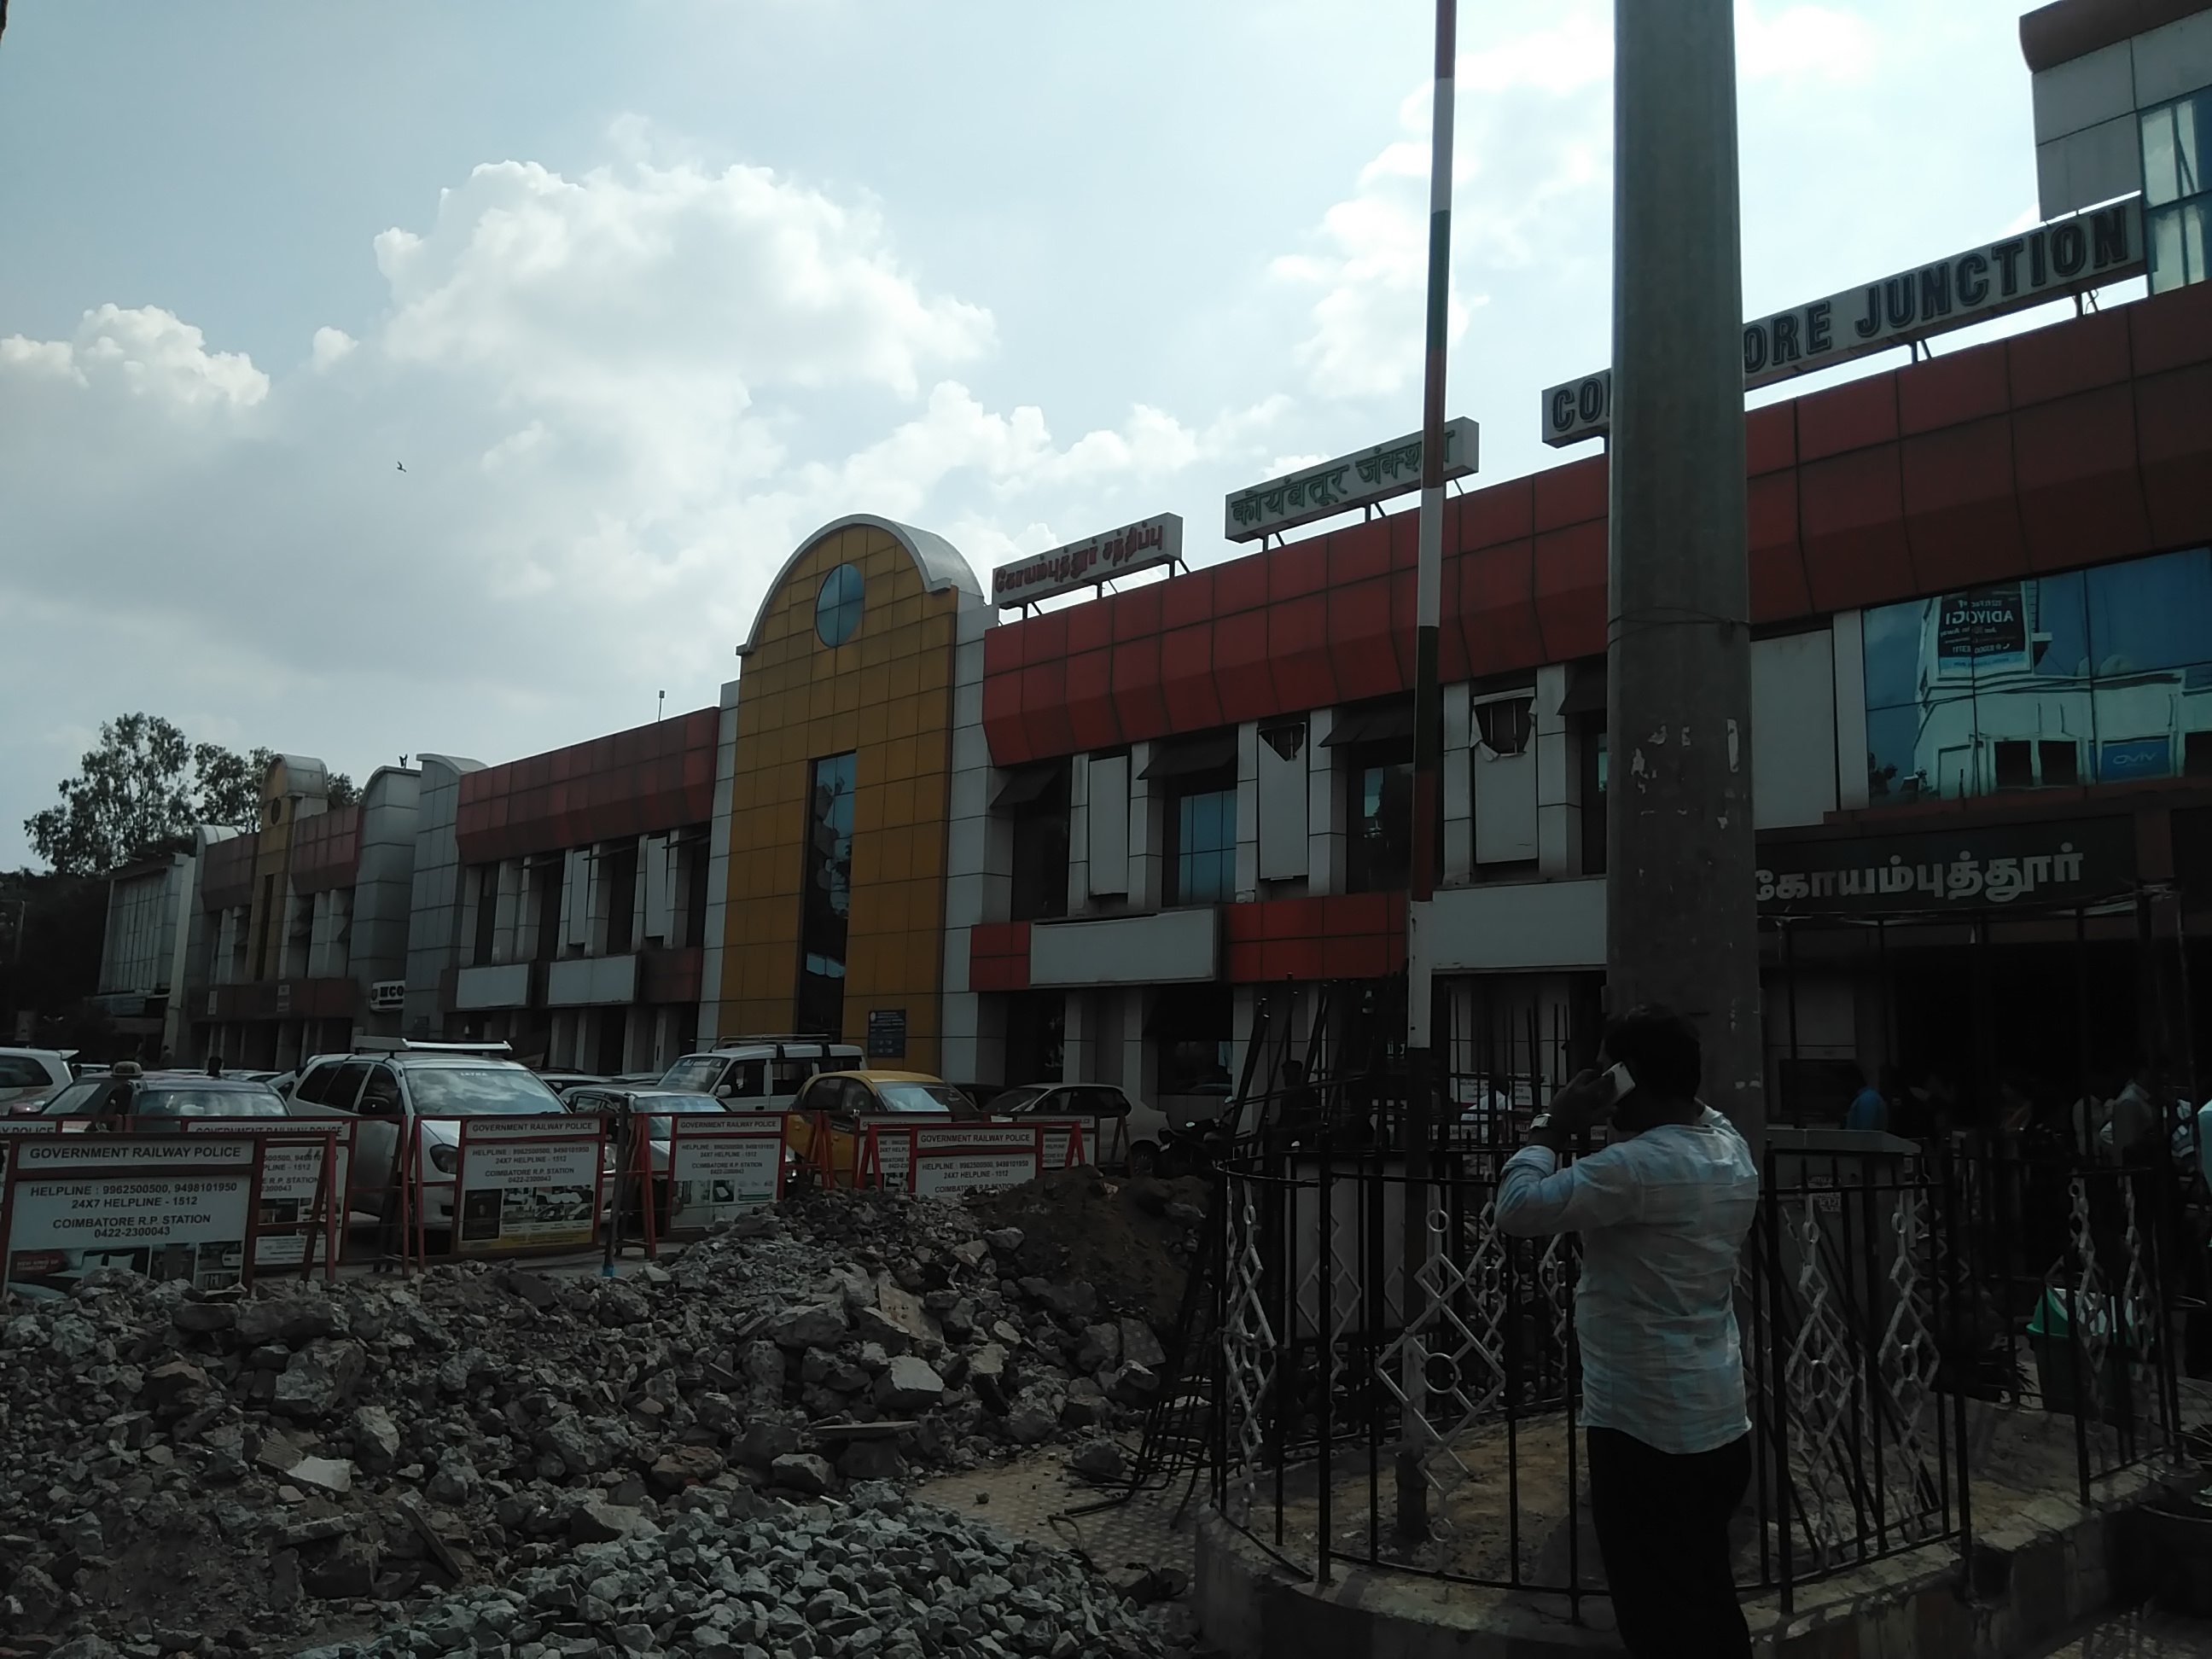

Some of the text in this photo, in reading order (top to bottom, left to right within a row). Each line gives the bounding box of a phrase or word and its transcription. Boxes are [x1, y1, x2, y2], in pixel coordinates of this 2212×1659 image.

[1553, 206, 2128, 432] COORE JUNCTION
[1355, 429, 1455, 484] जंक्श
[1755, 841, 2085, 903] கோயம்புத்தூர்
[921, 1134, 972, 1143] GOVERNMENT
[30, 1147, 242, 1159] GOVERNMENT RAILWAY POLICE
[31, 1186, 92, 1196] HELPLINE
[102, 1185, 171, 1195] 9962500500,
[174, 1183, 237, 1193] 9498101950
[72, 1199, 100, 1209] 24X7
[103, 1198, 162, 1208] HELPLINE
[173, 1197, 198, 1206] 1512
[53, 1217, 135, 1229] COIMBATORE
[163, 1214, 211, 1225] STATION
[94, 1227, 171, 1237] 0422-2300043
